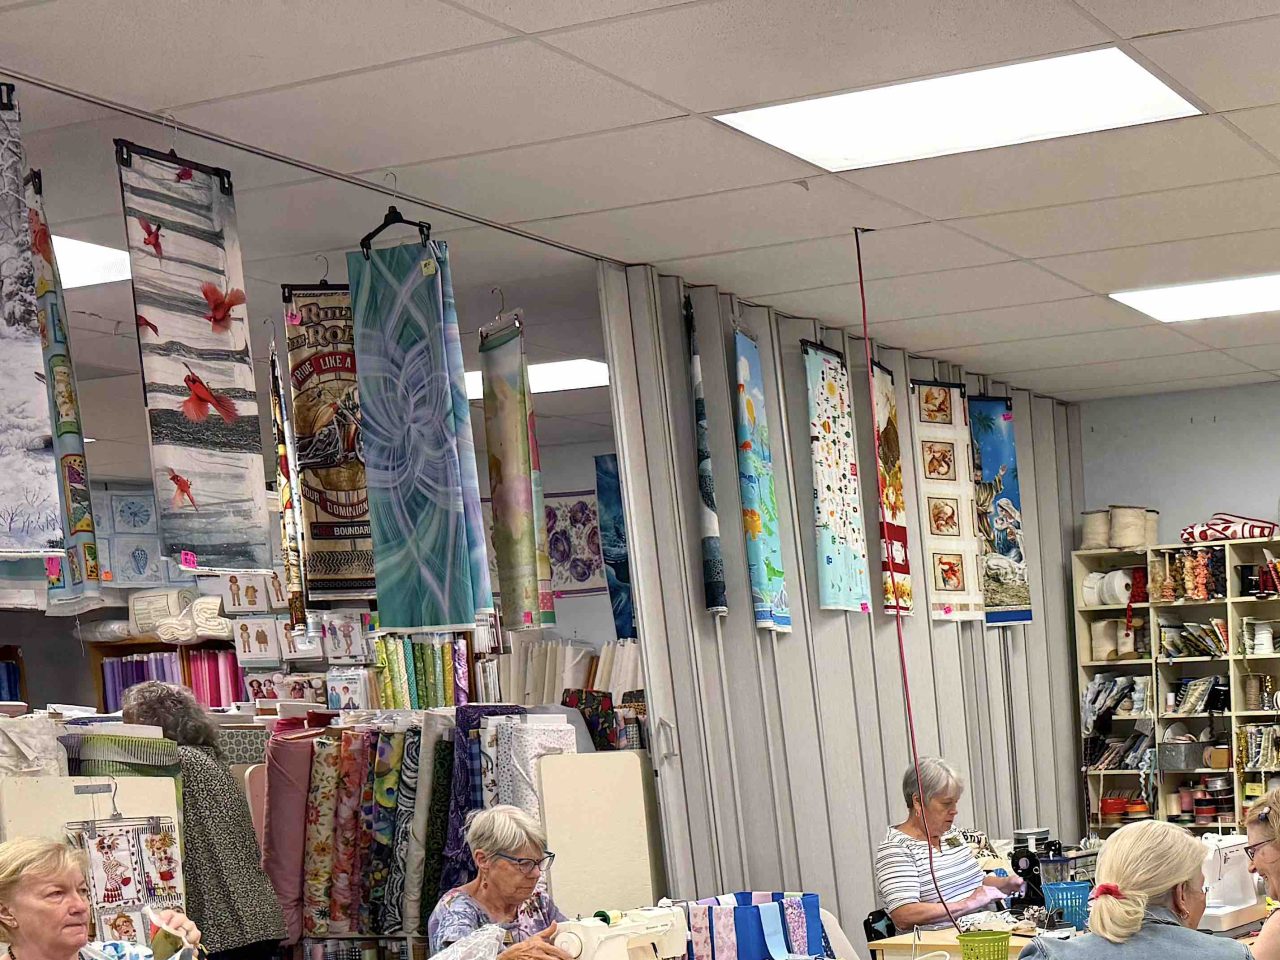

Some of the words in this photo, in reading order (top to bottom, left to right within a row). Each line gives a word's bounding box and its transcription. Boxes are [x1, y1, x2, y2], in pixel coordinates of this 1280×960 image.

[295, 361, 314, 381] RIDE
[320, 355, 342, 369] LIKE
[345, 356, 352, 368] A
[327, 500, 368, 517] DOMINION
[334, 525, 371, 536] BOUNDARI
